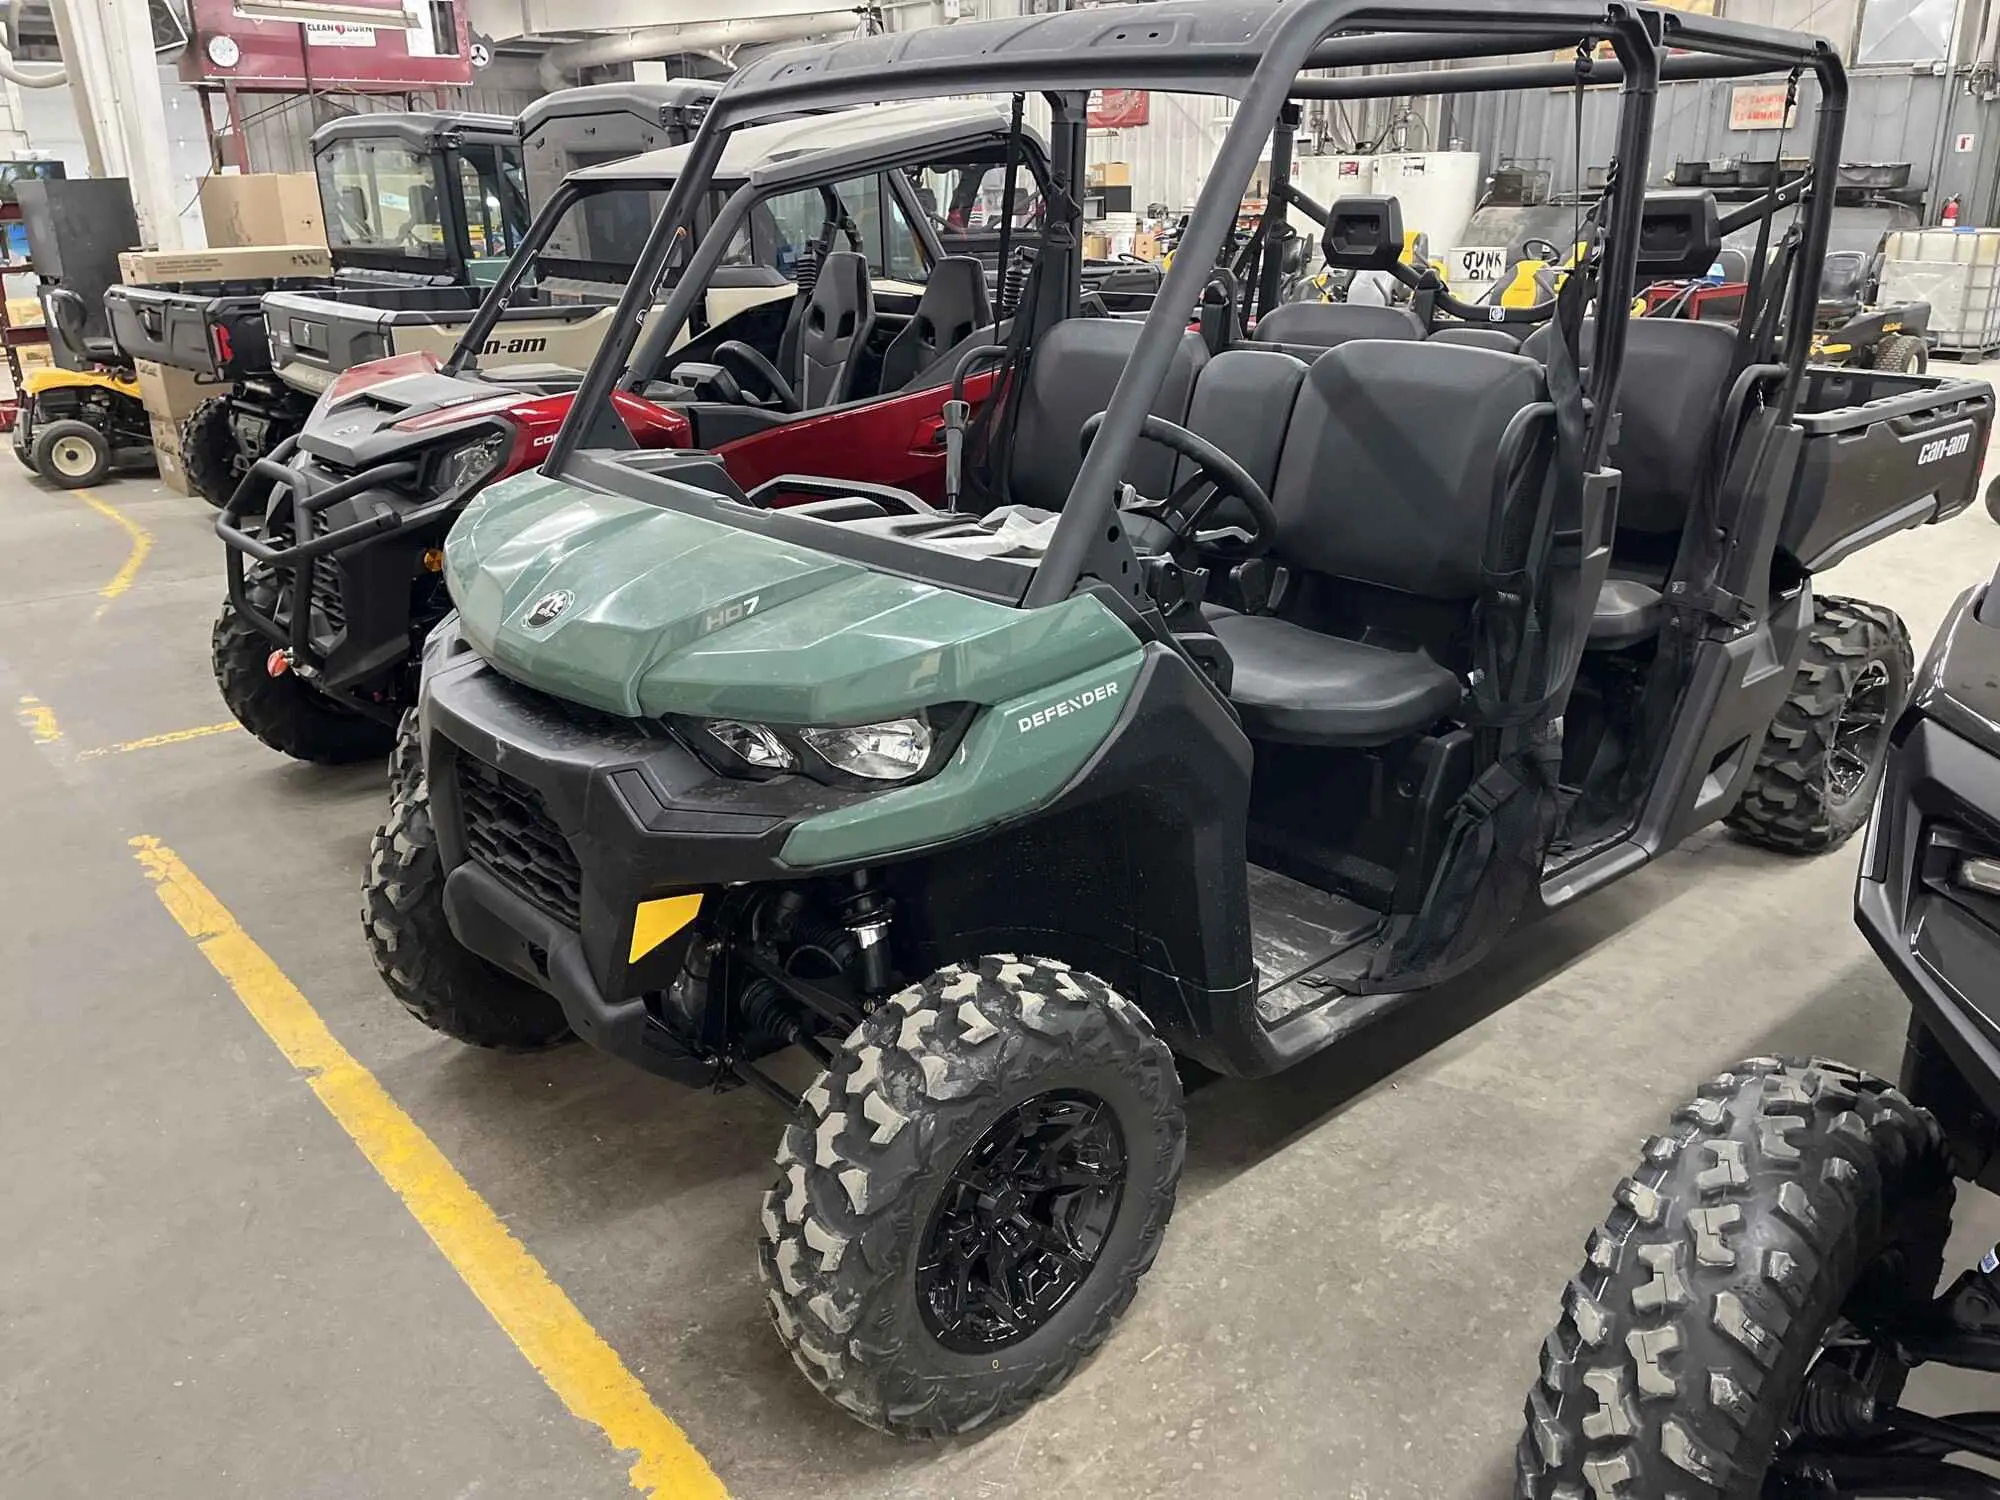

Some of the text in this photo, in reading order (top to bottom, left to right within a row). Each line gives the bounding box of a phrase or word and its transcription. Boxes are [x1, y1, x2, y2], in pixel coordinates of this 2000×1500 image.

[307, 24, 334, 32] CLEAN
[1463, 251, 1501, 270] JUNK
[1469, 269, 1495, 281] OIL
[1917, 432, 1970, 465] can-am
[706, 595, 760, 632] HD7
[1018, 681, 1119, 734] DEFENDER
